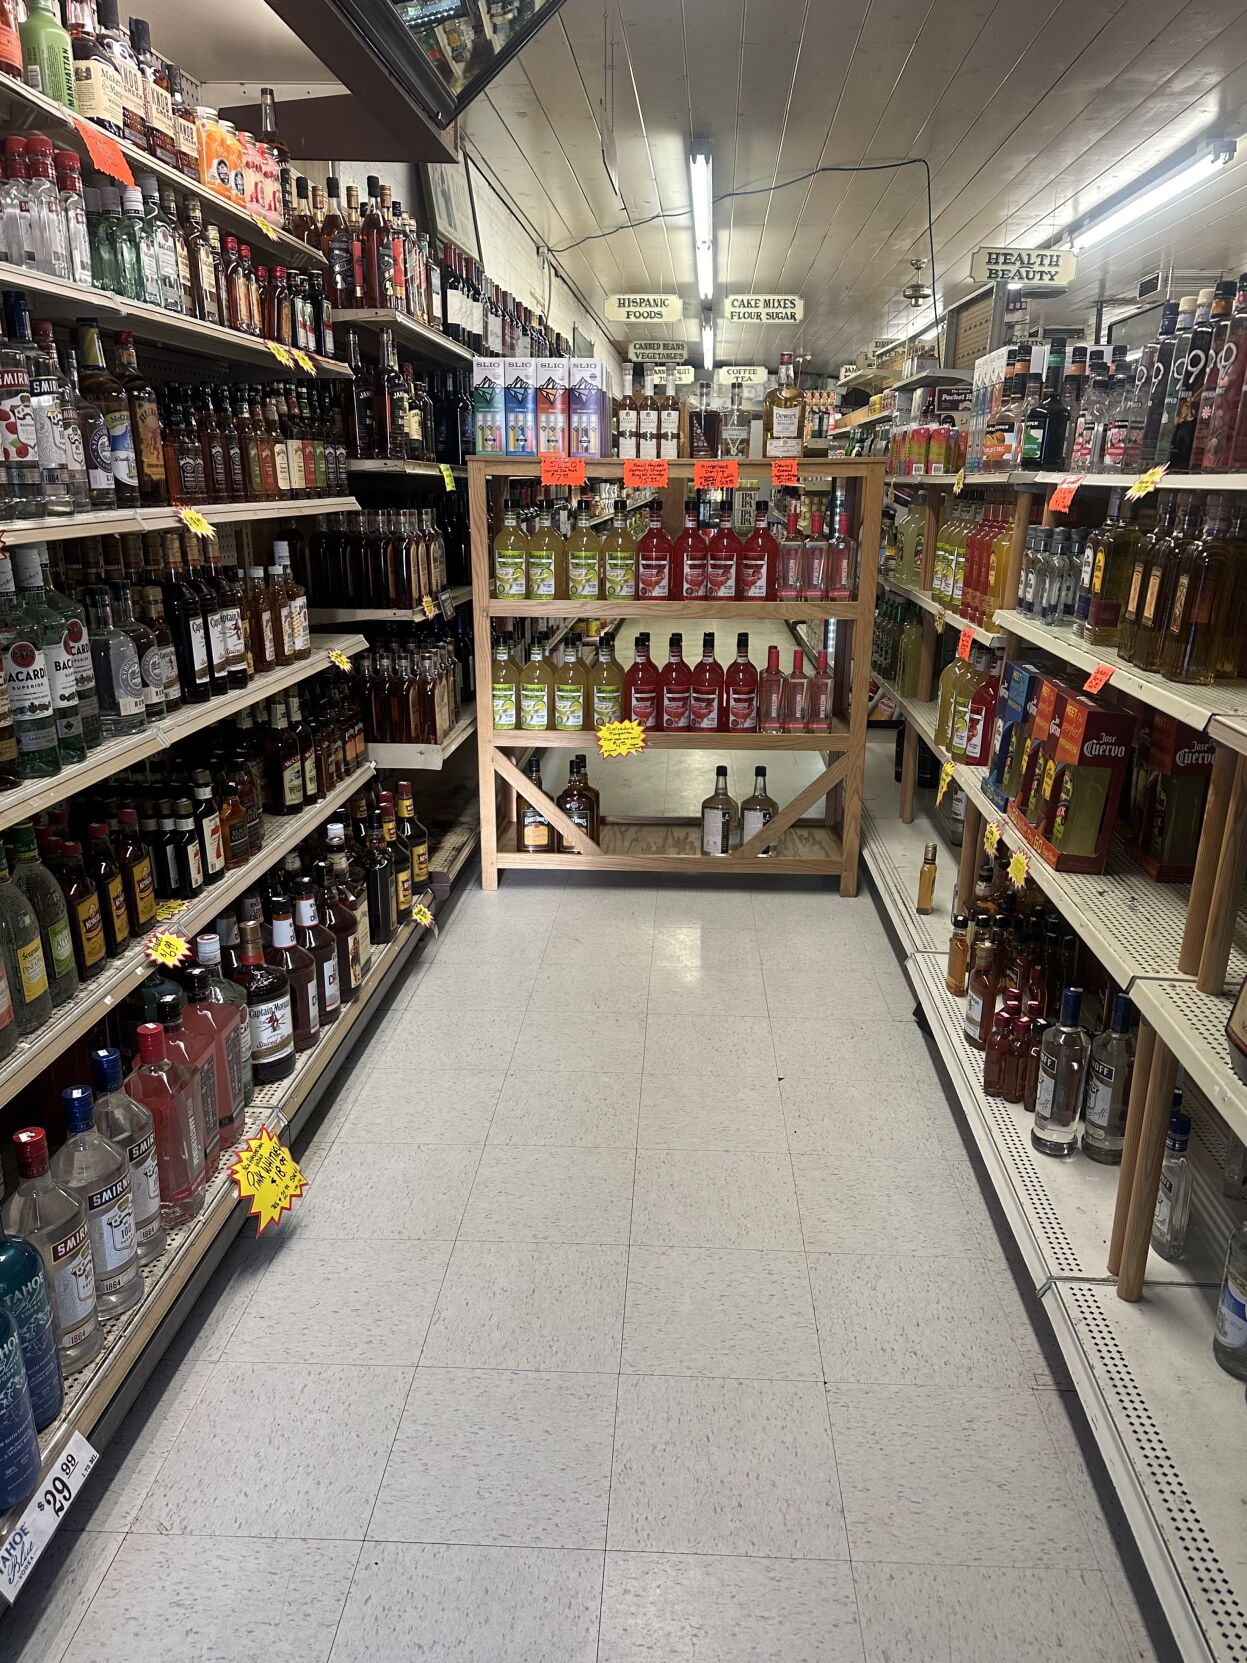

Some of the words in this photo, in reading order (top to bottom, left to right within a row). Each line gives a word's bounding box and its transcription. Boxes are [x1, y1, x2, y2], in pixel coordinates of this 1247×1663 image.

[62, 47, 75, 108] MANHATTAN
[150, 86, 170, 113] KNOB
[986, 251, 1062, 267] HEALTH
[987, 268, 1060, 282] BEAUTY
[617, 297, 670, 308] HISPANIC
[731, 298, 760, 309] CAKE
[763, 298, 797, 309] MIXES
[625, 310, 664, 320] FOODS
[730, 311, 763, 322] FLOUR
[765, 311, 798, 322] SUGAR
[633, 342, 661, 351] CANNED
[662, 342, 685, 351] BEANS
[634, 352, 684, 361] VEGETABLES
[727, 368, 758, 376] COFFEE
[733, 375, 753, 383] TEA
[741, 500, 753, 509] IPA
[12, 682, 44, 691] SUPERIOR
[1100, 732, 1117, 743] Jose
[1083, 740, 1126, 758] Cuervo
[1191, 740, 1209, 752] Jose
[249, 1004, 273, 1019] Captain
[4, 1270, 45, 1306] TAHOE
[105, 1278, 122, 1292] 1864
[70, 1330, 87, 1345] 1864
[18, 1556, 35, 1582] VODKA
